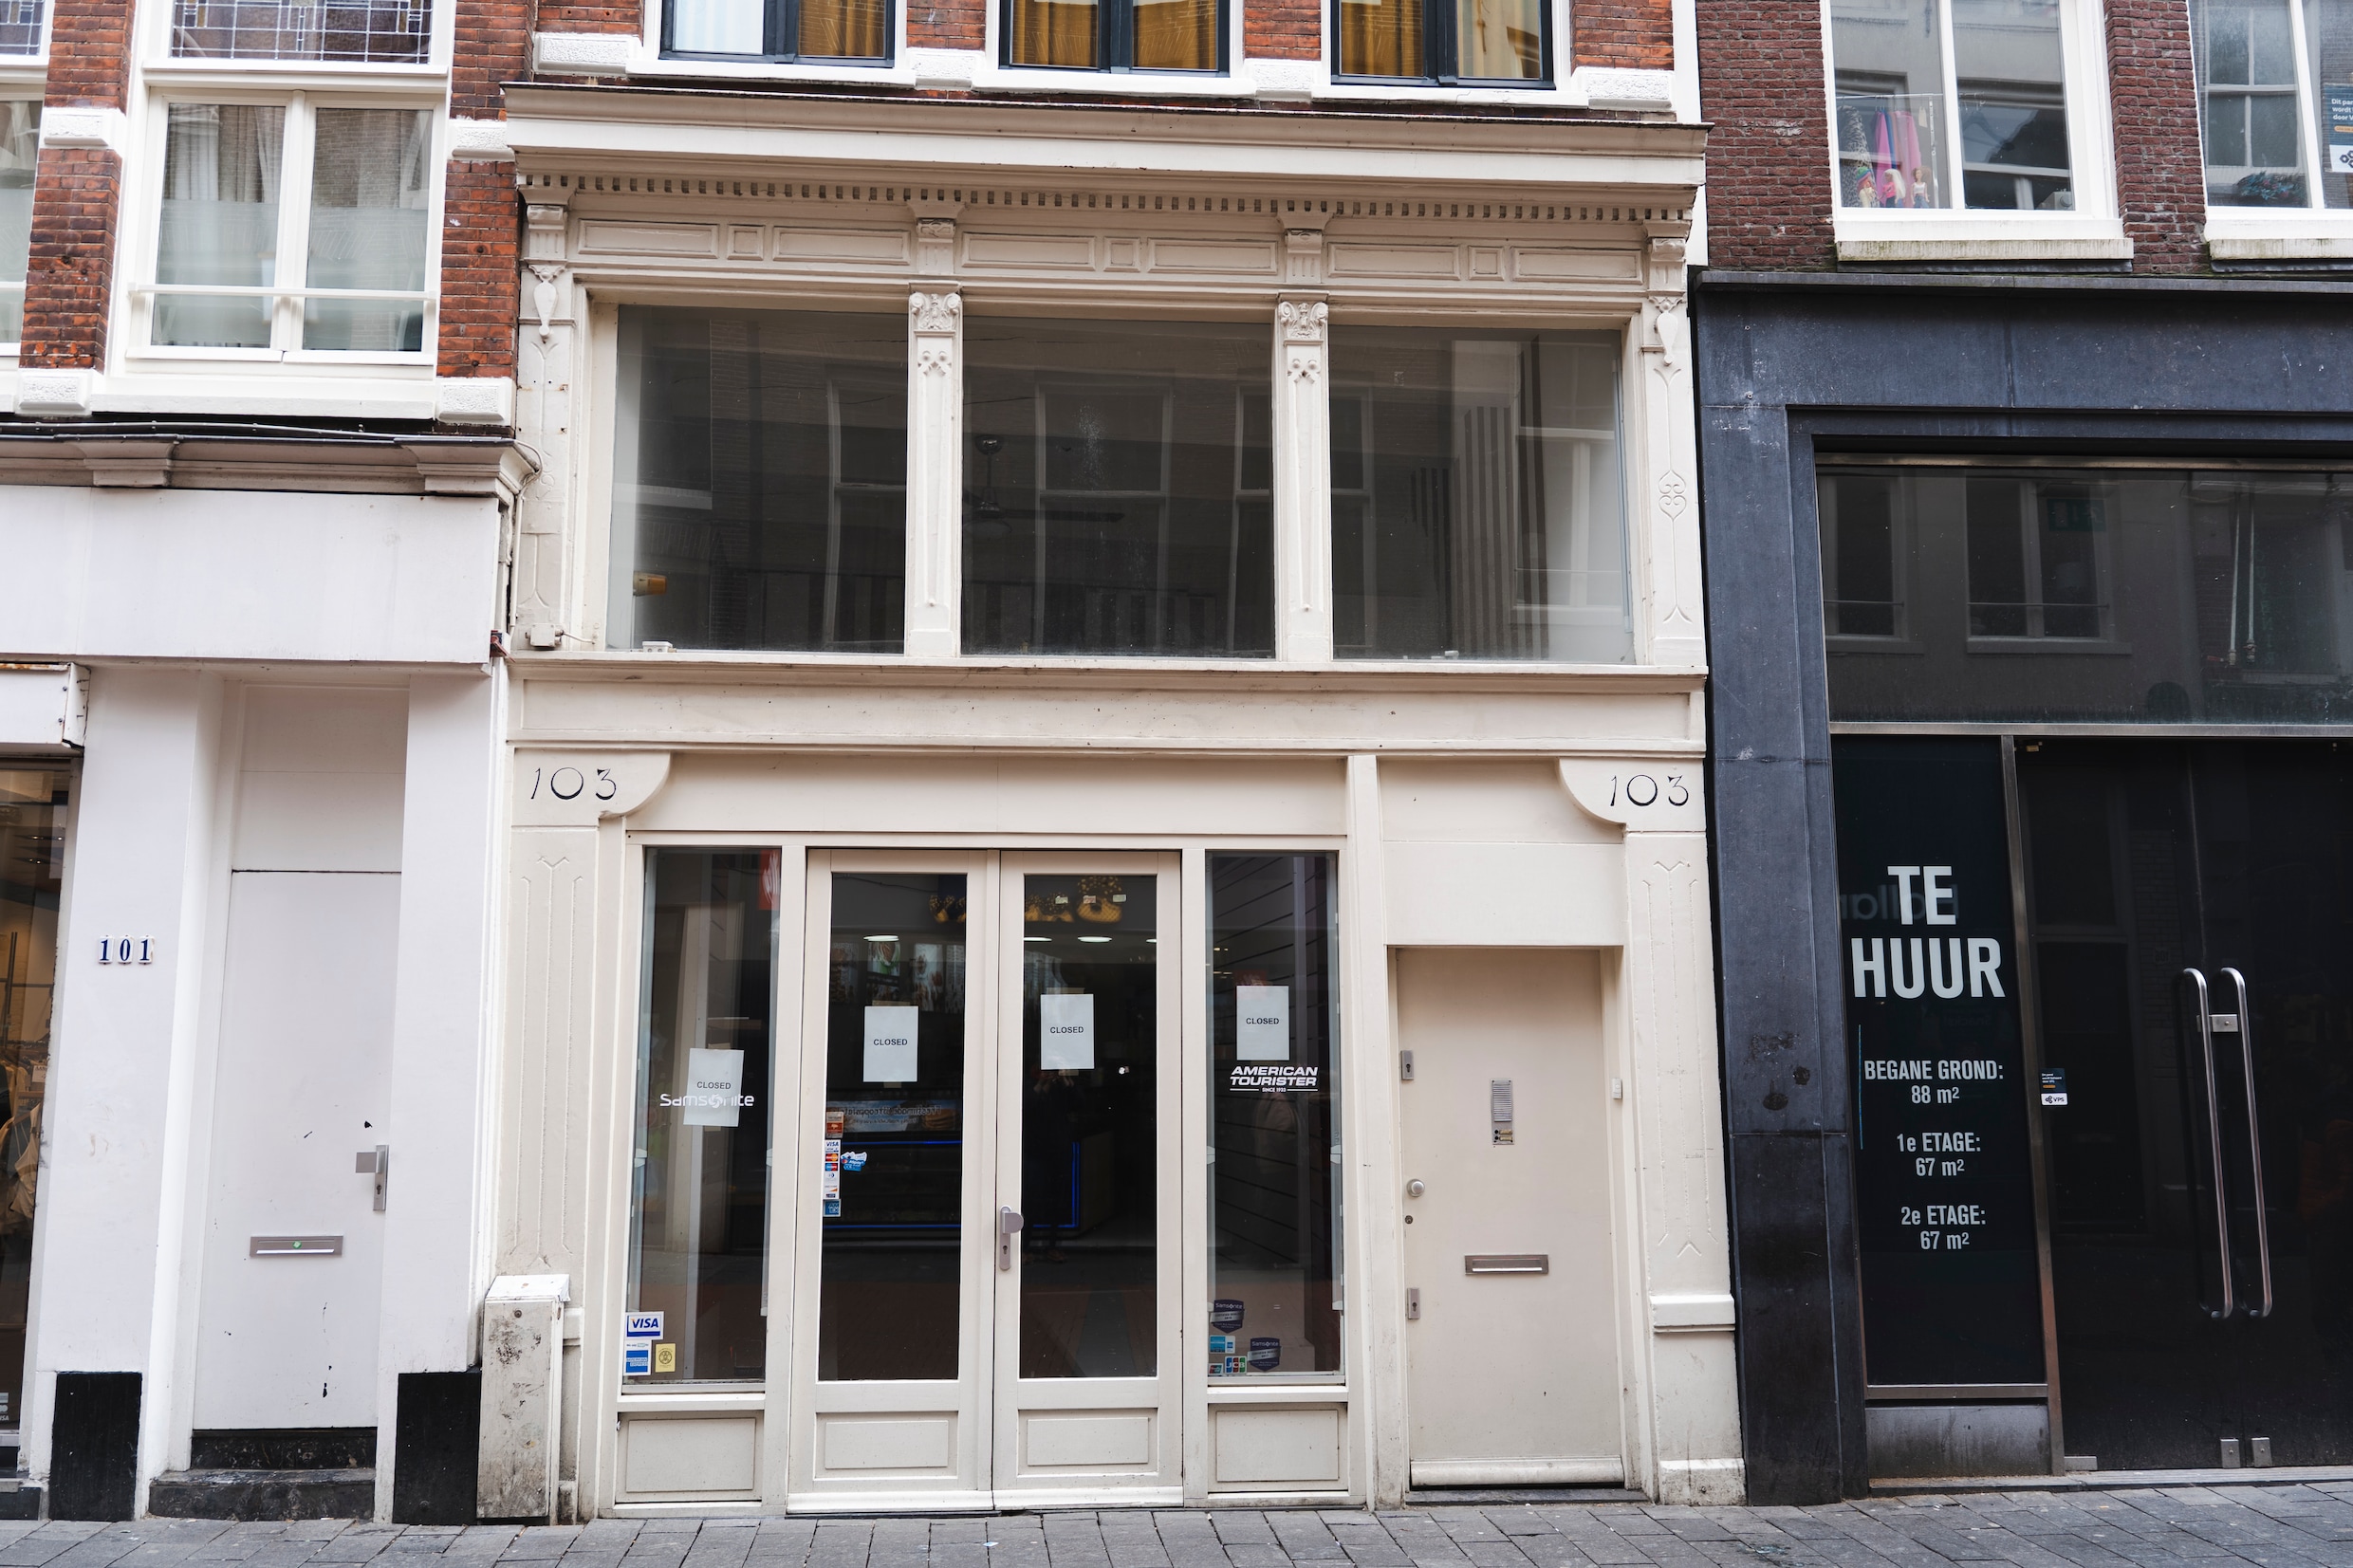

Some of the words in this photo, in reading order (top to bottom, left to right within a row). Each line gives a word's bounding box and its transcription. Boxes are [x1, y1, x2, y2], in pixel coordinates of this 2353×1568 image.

[530, 766, 617, 801] 103
[1610, 774, 1689, 807] 103
[1887, 865, 1956, 925] TE
[99, 938, 150, 962] 101
[1851, 937, 2006, 999] HUUR
[1231, 1065, 1319, 1077] AMERICAN
[1863, 1060, 1933, 1080] BEGANE
[1937, 1060, 2004, 1080] GROND:
[696, 1081, 732, 1090] CLOSED
[1230, 1076, 1317, 1086] TOURISTER
[659, 1093, 755, 1109] Samsonite
[1911, 1084, 1931, 1104] 88
[1897, 1133, 1917, 1153] 1e
[1921, 1132, 1981, 1153] ETAGE:
[1915, 1157, 1936, 1176] 67
[1900, 1206, 1921, 1226] 2e
[1926, 1205, 1986, 1226] ETAGE:
[1919, 1230, 1940, 1250] 67
[631, 1318, 659, 1329] VISA
